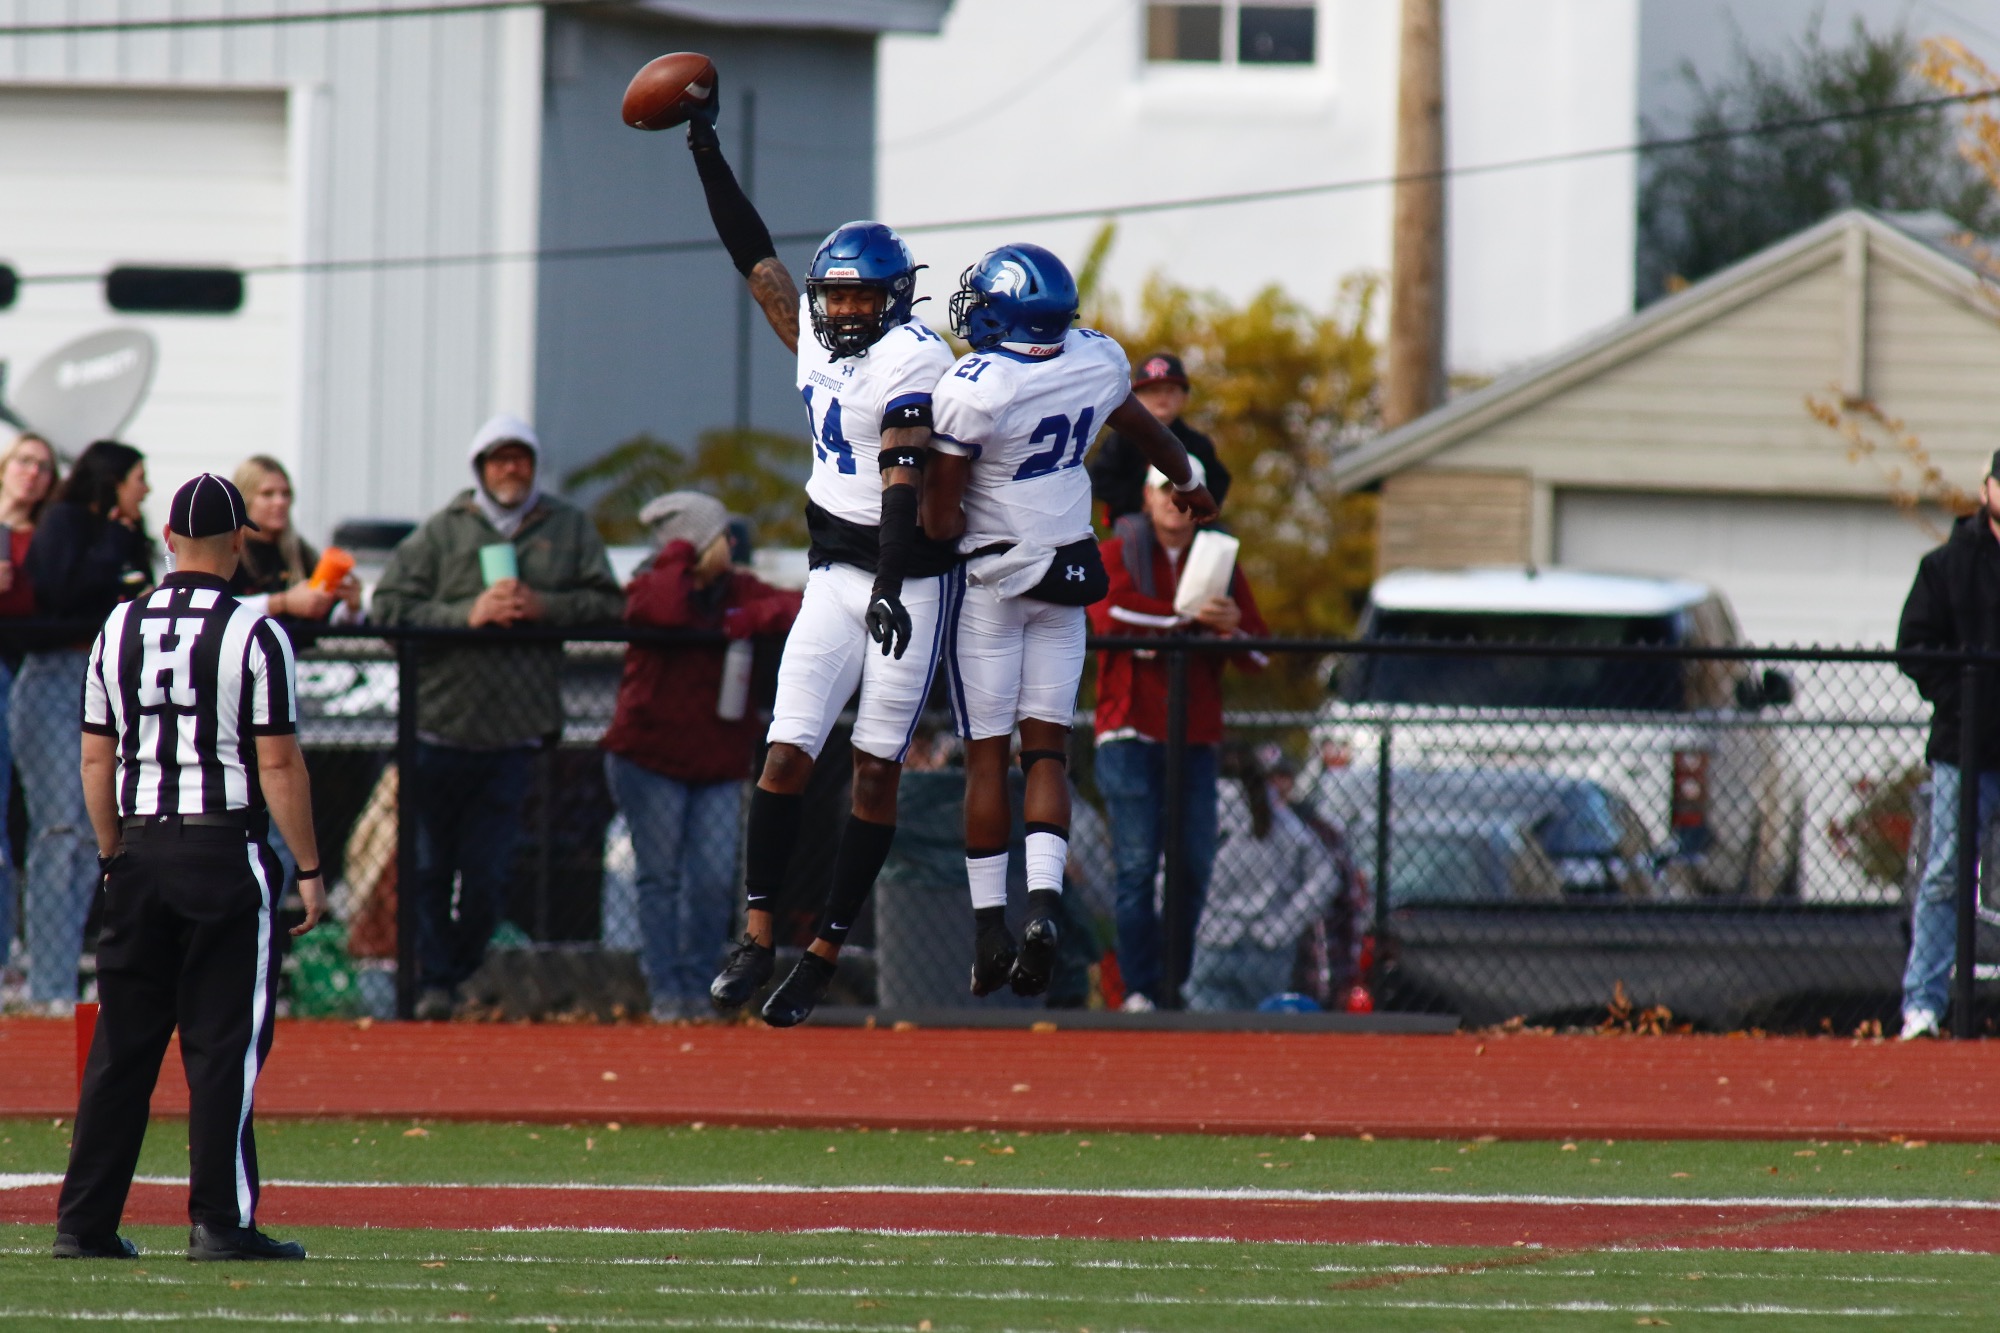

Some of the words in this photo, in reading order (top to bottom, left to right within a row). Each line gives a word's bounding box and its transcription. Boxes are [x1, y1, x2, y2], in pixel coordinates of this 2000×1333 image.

[828, 269, 855, 277] Riddell
[903, 324, 941, 342] 14
[808, 370, 845, 393] DUBUQUE
[954, 357, 992, 383] 21
[801, 384, 857, 475] 14
[1012, 405, 1095, 482] 21
[137, 617, 205, 707] H
